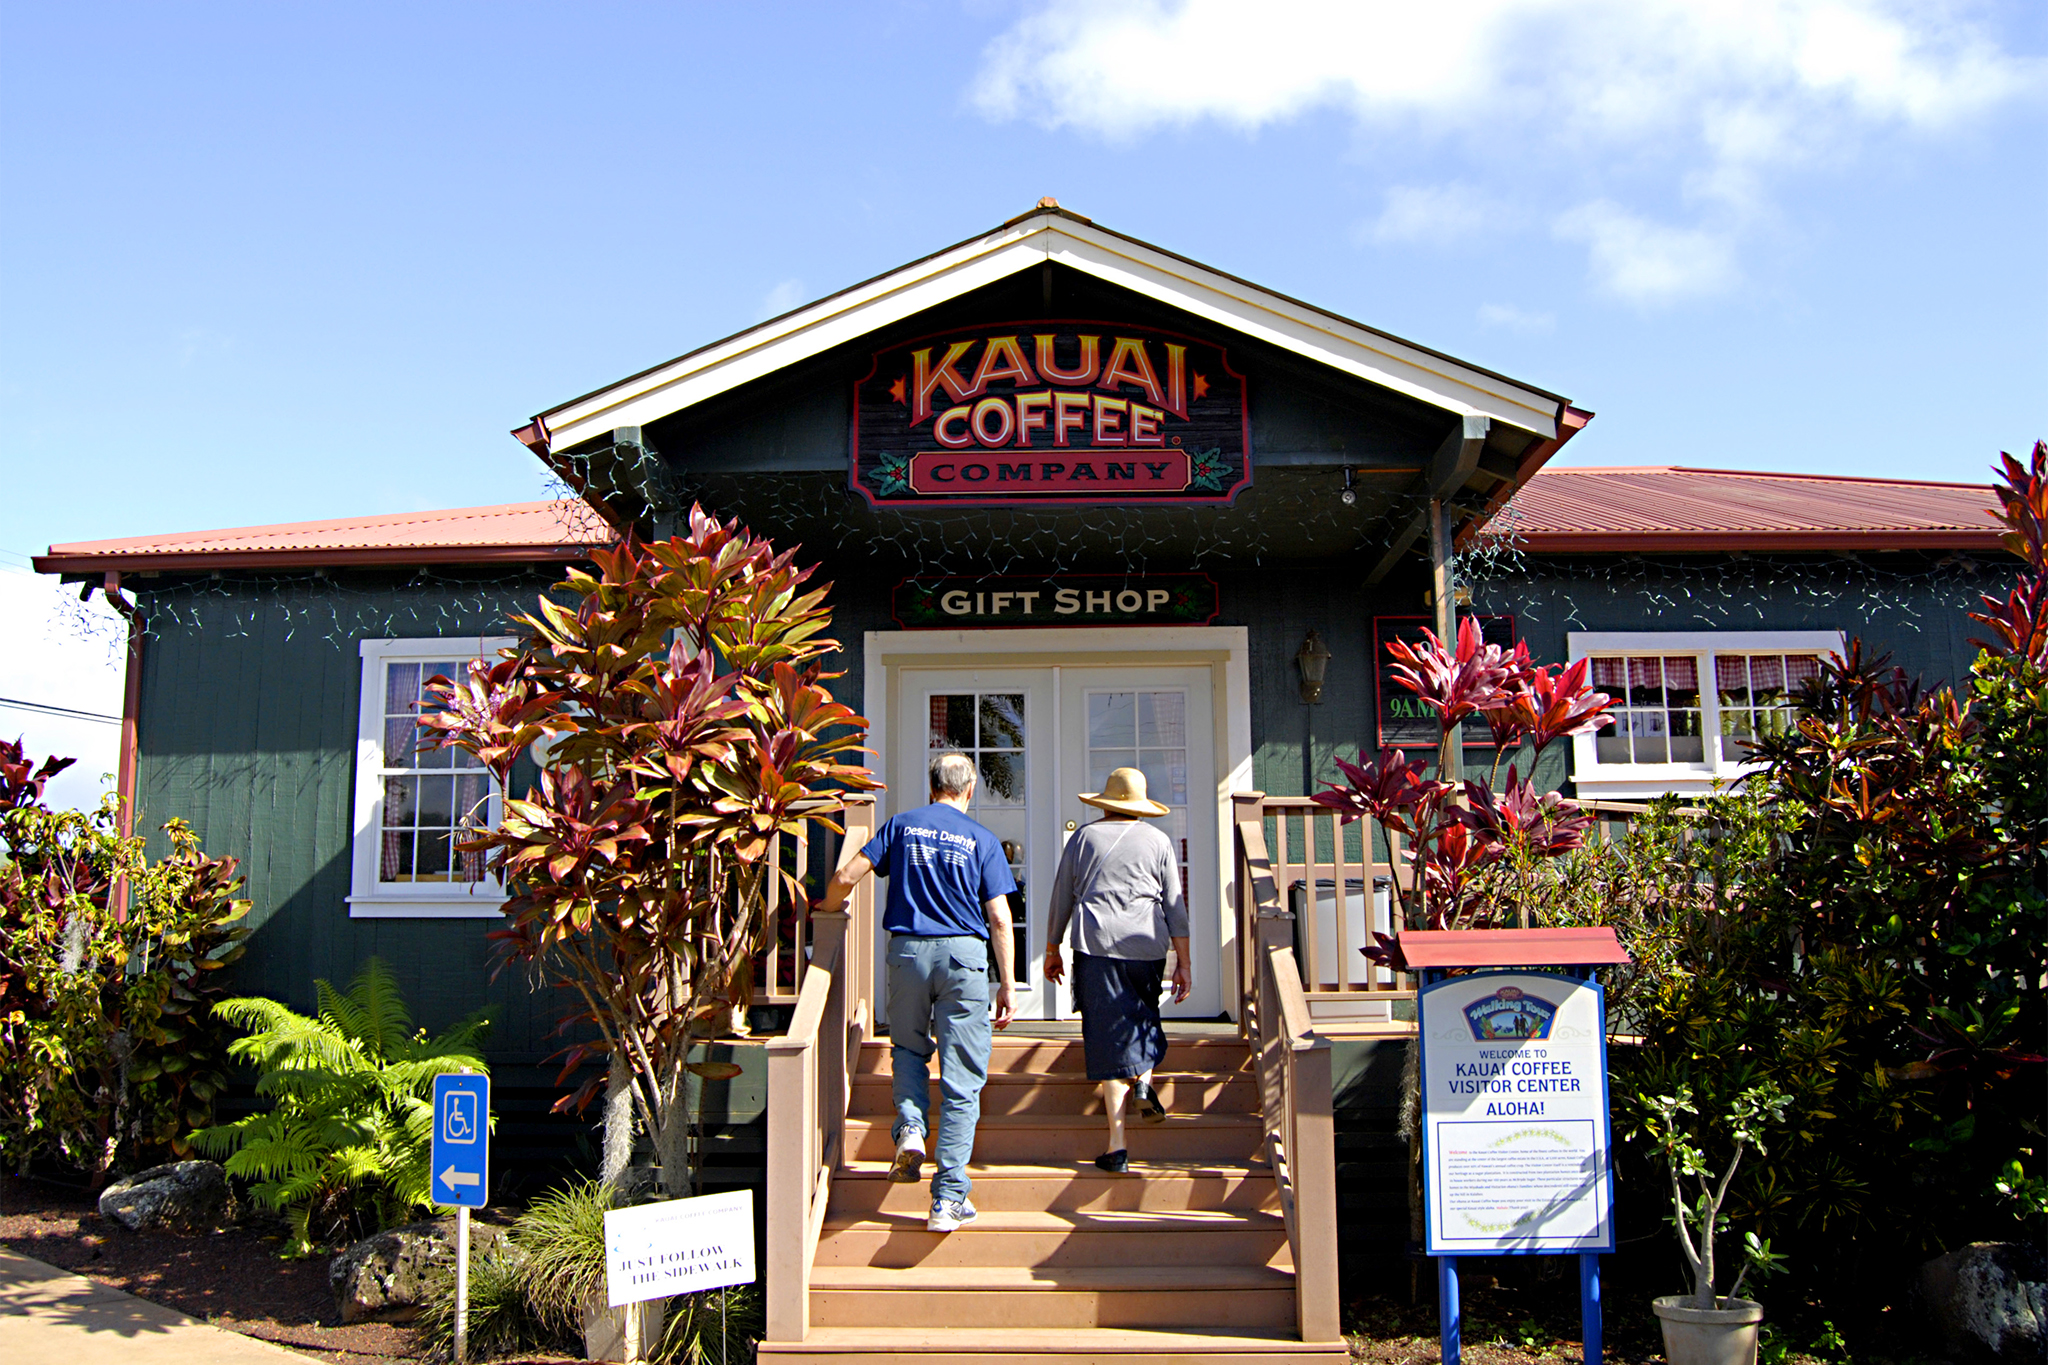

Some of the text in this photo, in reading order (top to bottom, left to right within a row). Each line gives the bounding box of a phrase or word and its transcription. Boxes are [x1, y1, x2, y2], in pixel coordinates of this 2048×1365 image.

[909, 333, 1190, 428] KAUAI
[933, 388, 1165, 449] COFFEE
[930, 462, 1172, 482] COMPANY
[940, 588, 1170, 615] GIFT SHOP
[904, 826, 967, 845] Desert Dash
[1470, 998, 1551, 1020] Walking Tour
[1479, 1049, 1547, 1059] WELCOME TO
[1456, 1061, 1572, 1076] KAUAI COFFEE
[1449, 1078, 1580, 1094] VISITOR CENTER
[1486, 1101, 1545, 1116] ALOHA!
[708, 1206, 743, 1215] COMPANY
[619, 1245, 725, 1272] JUST FOLLOW
[631, 1257, 743, 1285] THE SIDEWALK
